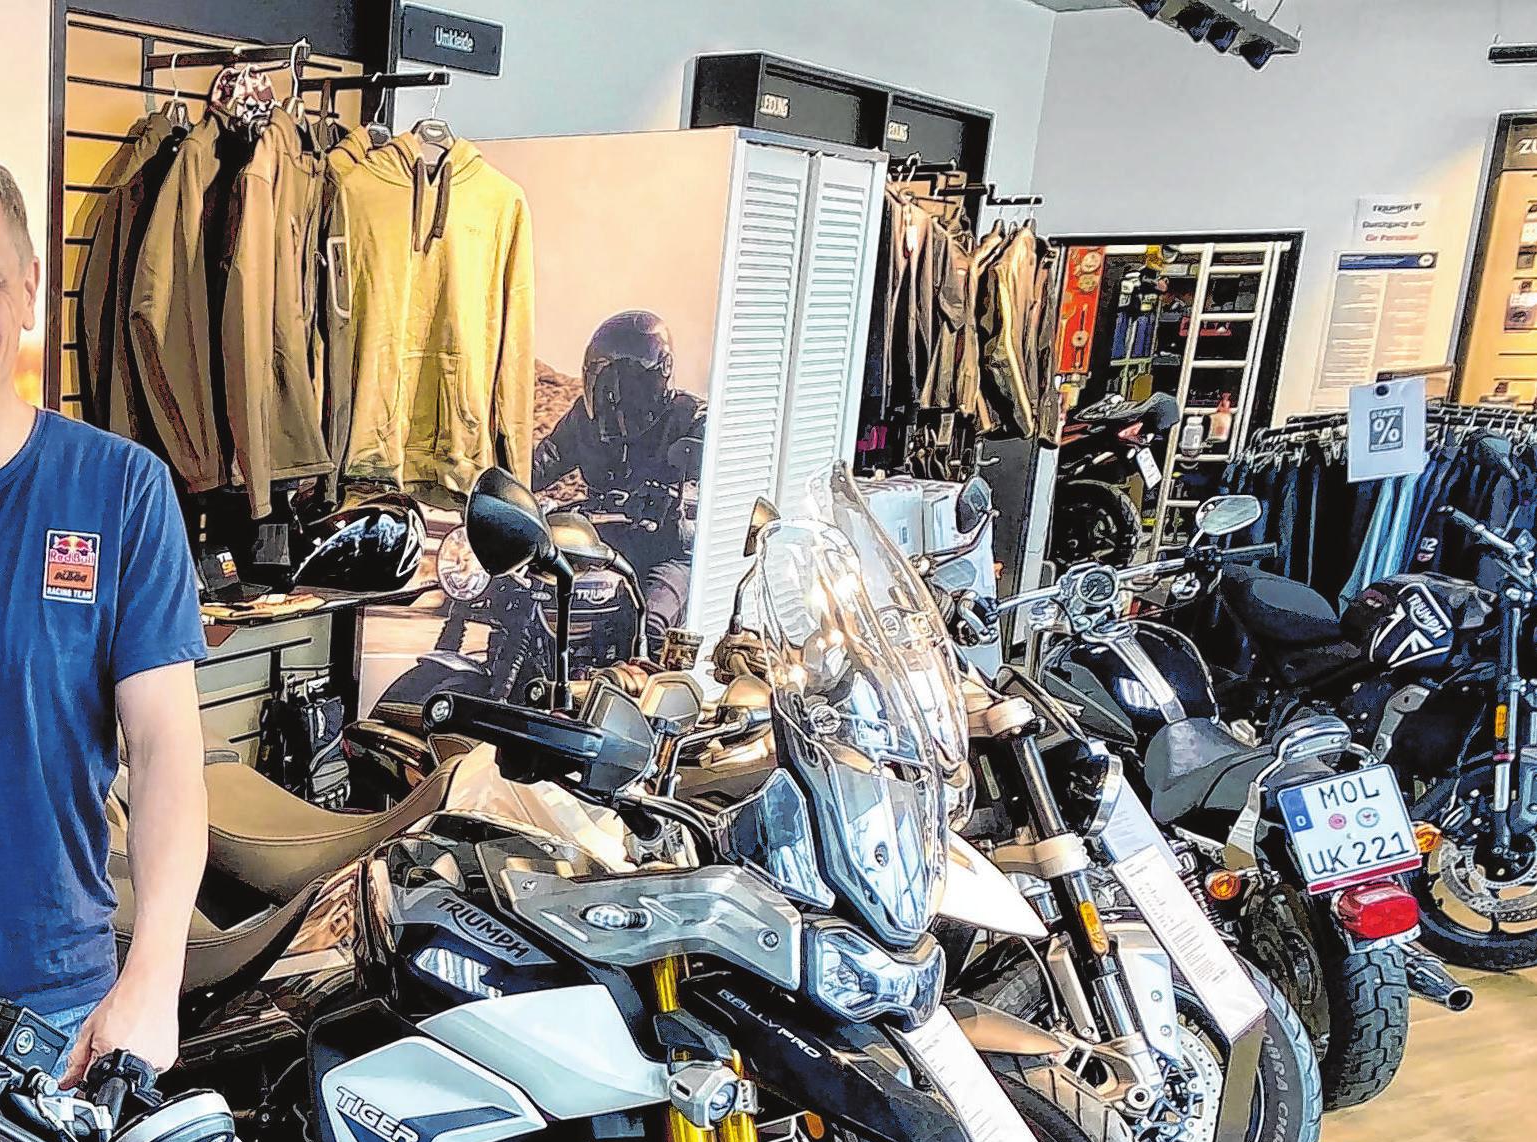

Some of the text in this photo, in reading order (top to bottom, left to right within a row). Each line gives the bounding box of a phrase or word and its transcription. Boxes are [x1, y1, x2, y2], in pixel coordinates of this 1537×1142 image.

[1407, 592, 1447, 639] TRIUMPH
[1318, 776, 1381, 810] MOL
[1307, 831, 1410, 875] UK 221
[436, 897, 531, 959] TRIUMPH
